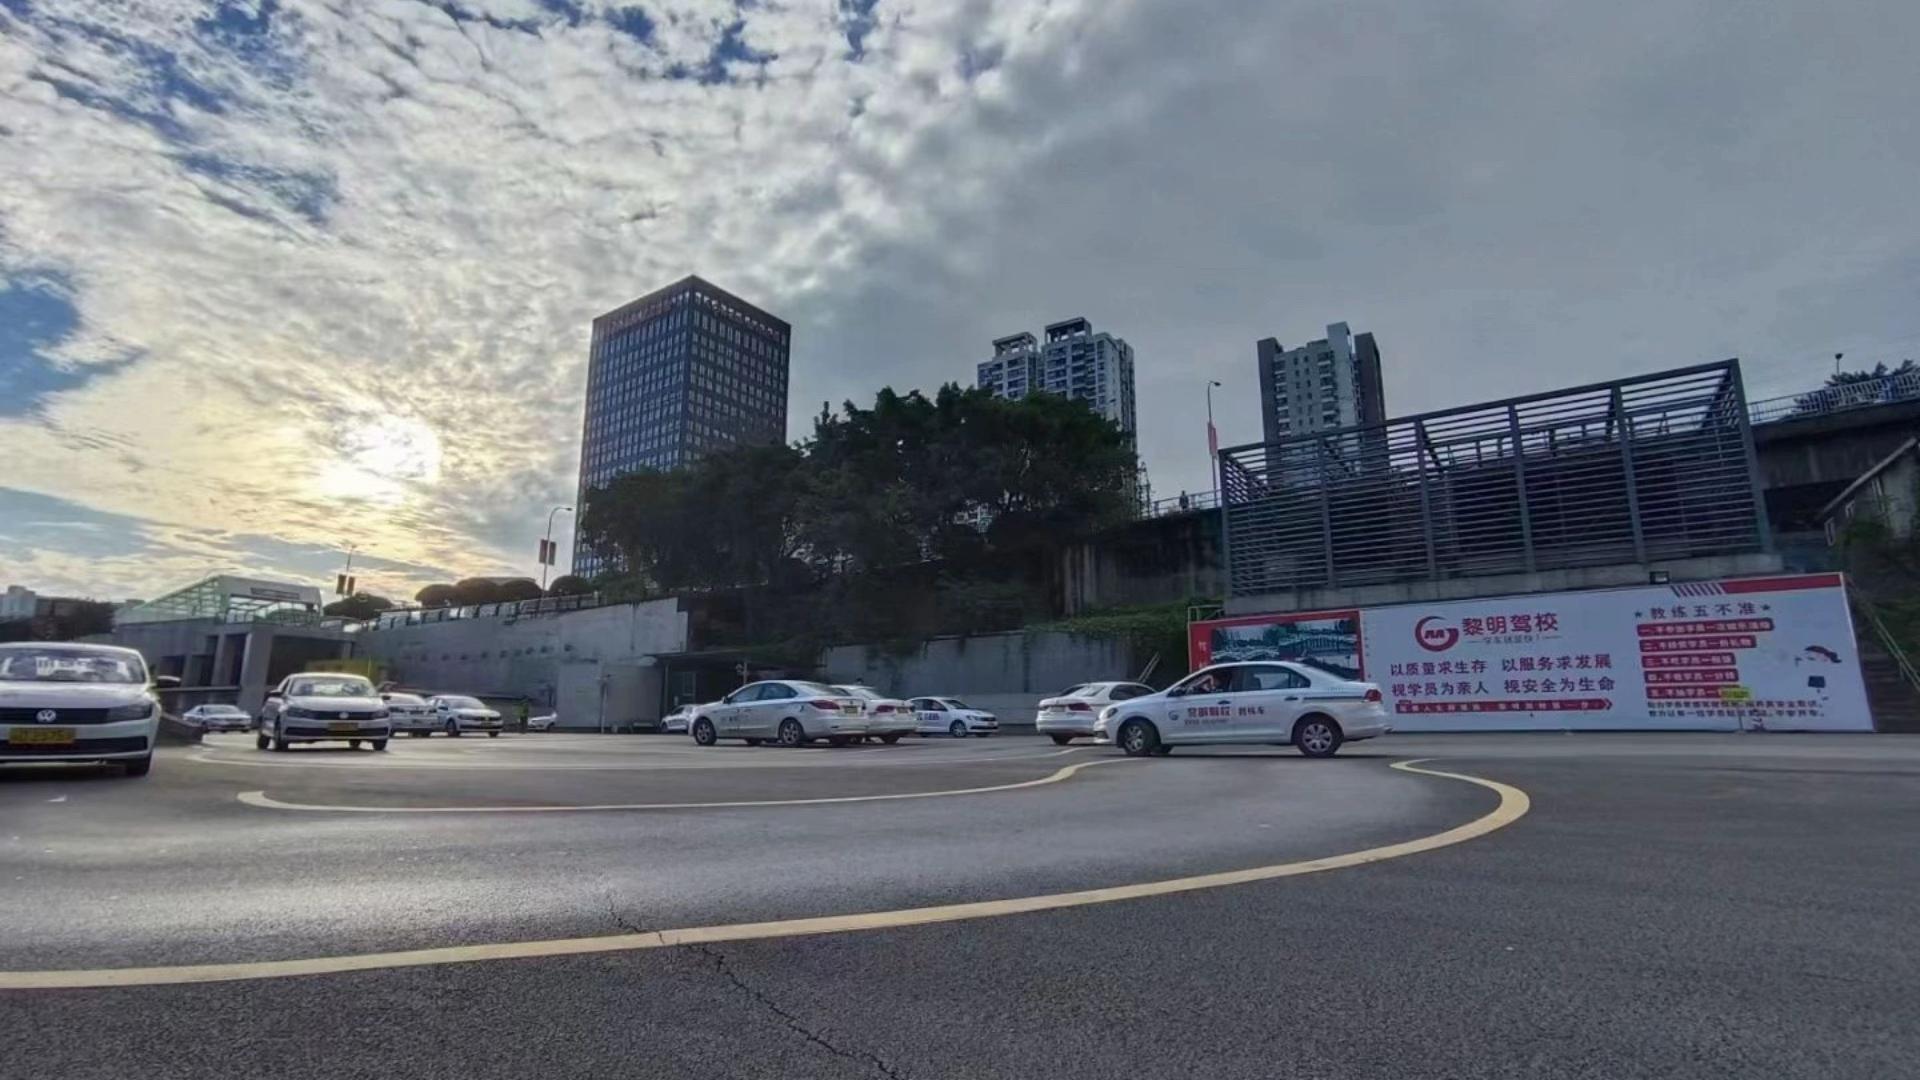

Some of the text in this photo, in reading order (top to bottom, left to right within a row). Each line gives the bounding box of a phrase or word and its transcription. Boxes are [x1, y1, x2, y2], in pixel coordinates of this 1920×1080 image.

[1651, 603, 1757, 619] 教练五不准
[1462, 612, 1559, 636] 黎明驾校
[1390, 653, 1613, 677] 以质量求生存 以服务求发展
[1391, 676, 1616, 697] 视学员为亲人 视安全为生命
